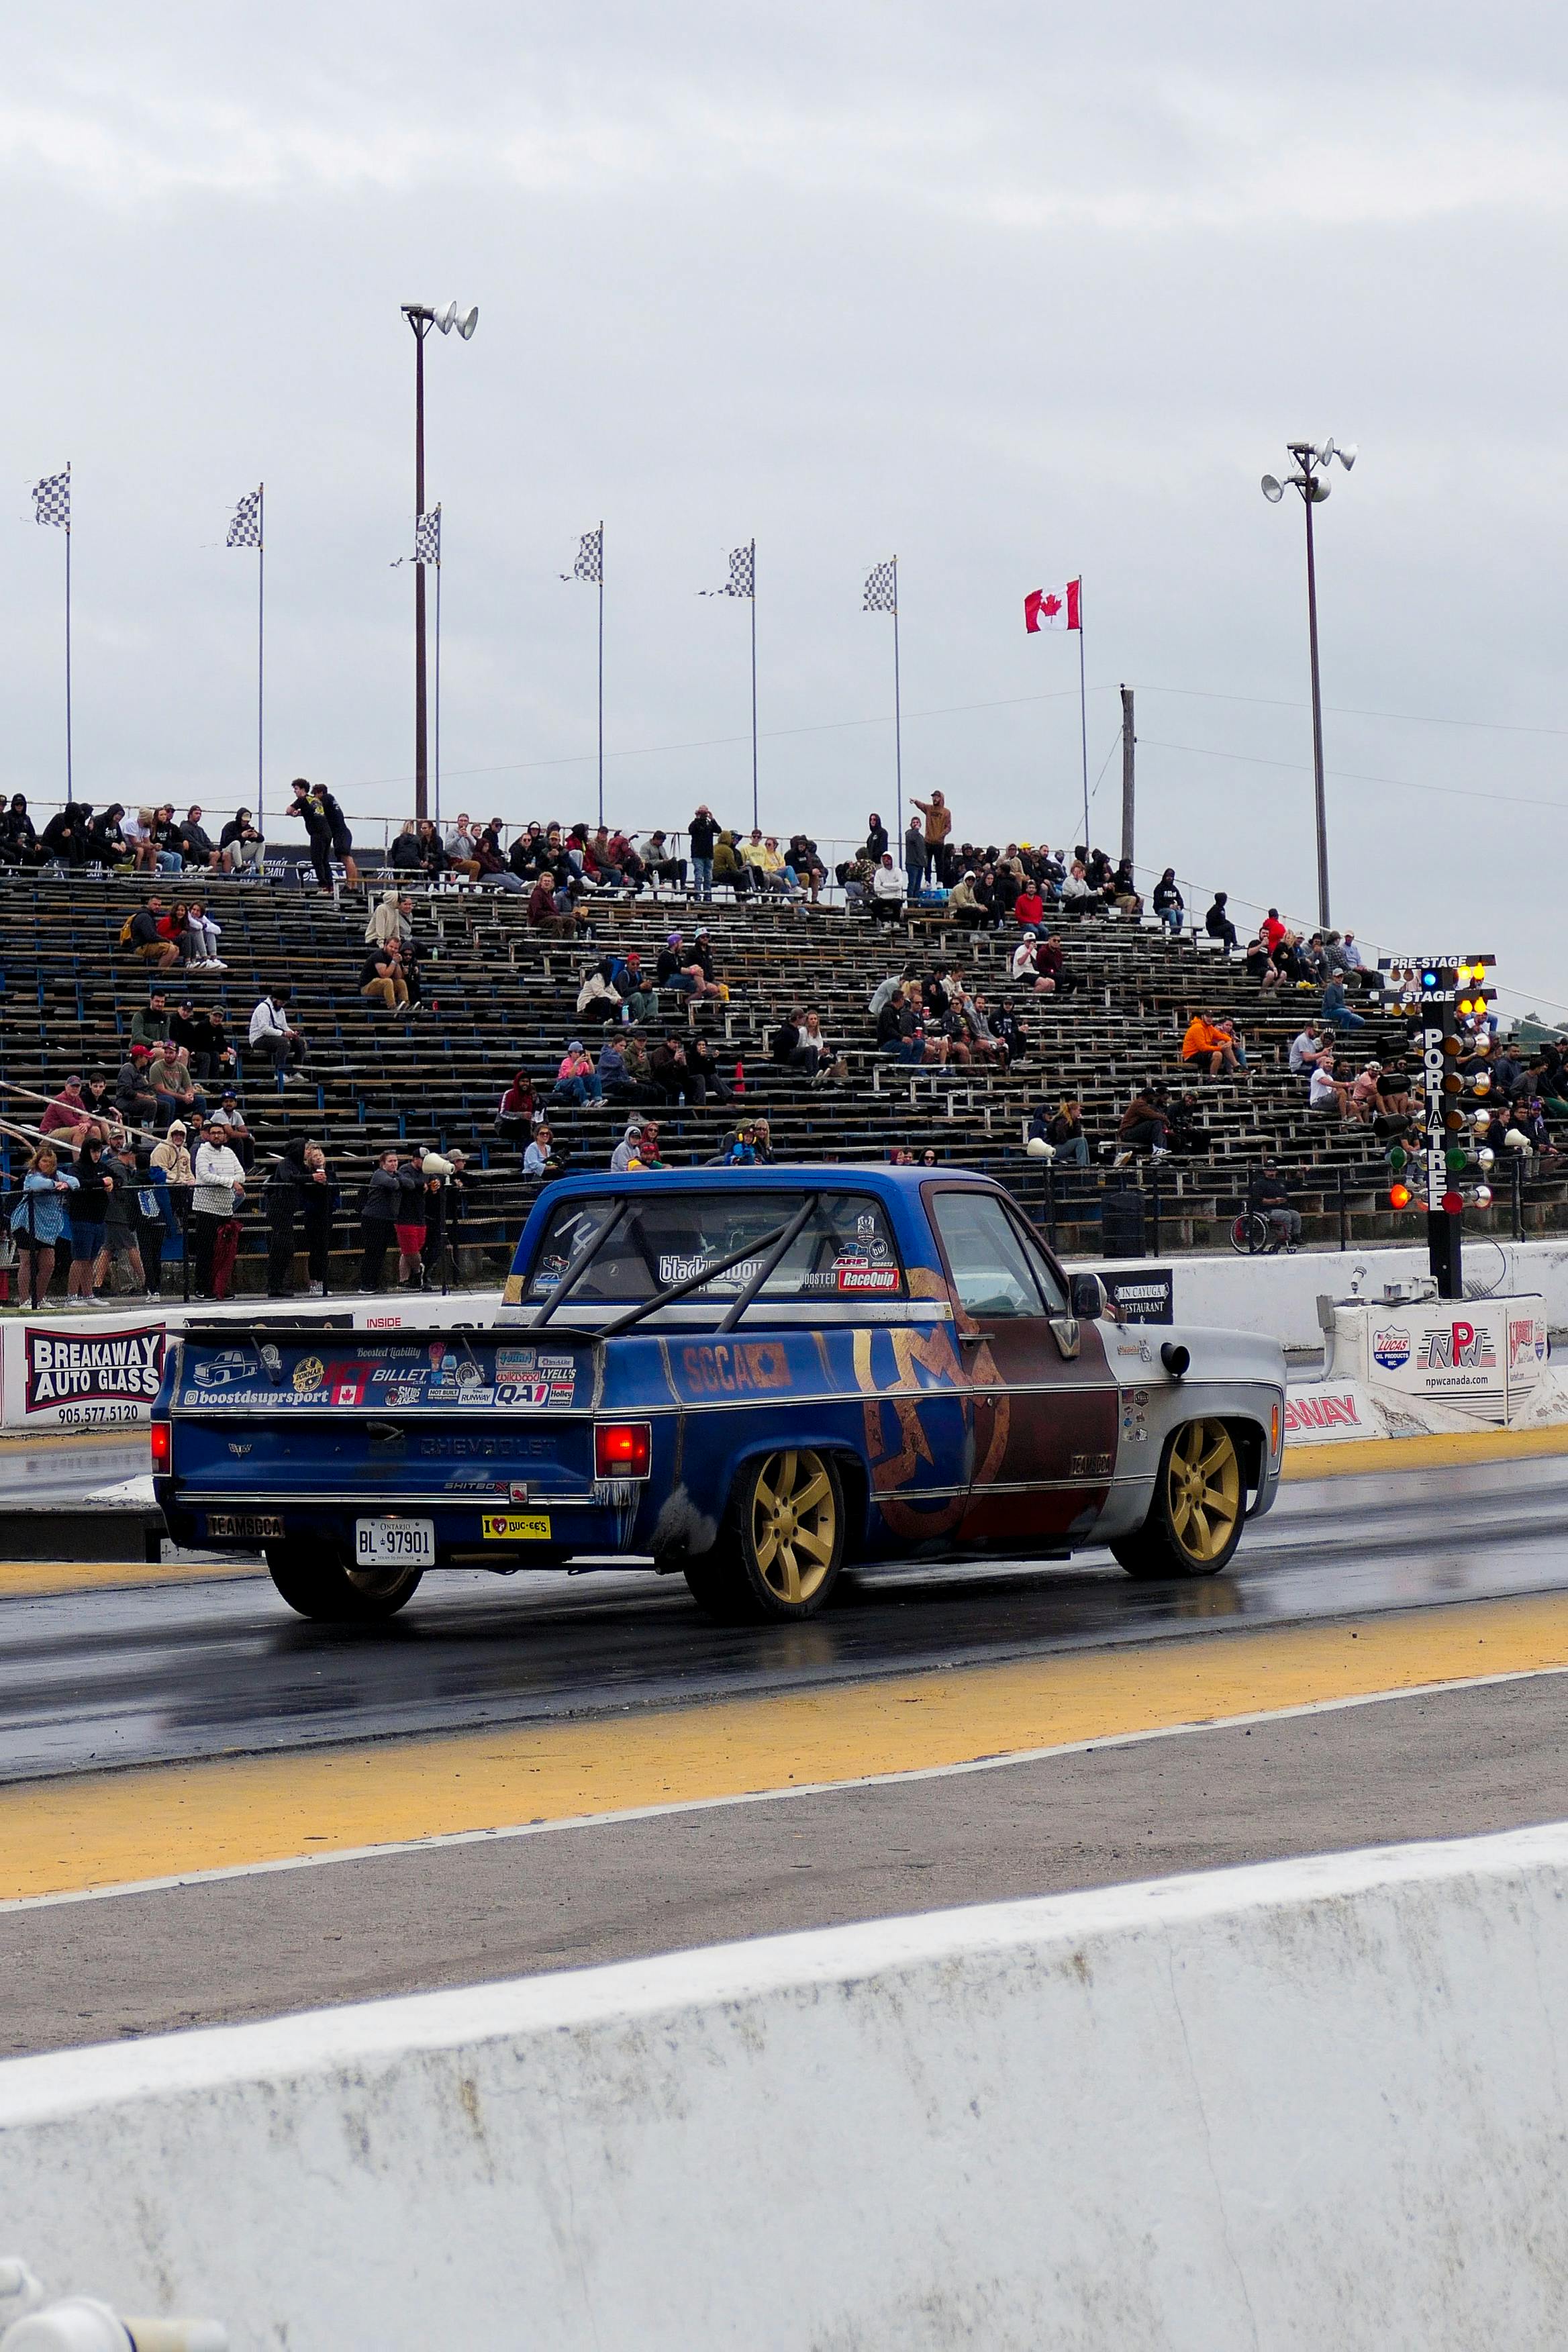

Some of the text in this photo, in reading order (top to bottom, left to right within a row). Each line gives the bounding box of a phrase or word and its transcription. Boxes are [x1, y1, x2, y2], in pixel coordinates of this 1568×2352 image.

[1389, 956, 1467, 969] PRE-STAGE
[1402, 990, 1456, 1003] STAGE
[1424, 1028, 1448, 1211] PORTATREE
[843, 1272, 895, 1287] RaceQuip
[1122, 1286, 1161, 1298] IN CAYUGA
[366, 1317, 401, 1328] INSIDE
[1377, 1340, 1408, 1351] LUCAS
[1428, 1322, 1483, 1368] NPW
[34, 1335, 160, 1369] BREAKAWAY
[356, 1347, 422, 1359] Boosted Liability
[540, 1369, 577, 1379] LYELL'S
[683, 1343, 754, 1393] SGCA
[372, 1369, 431, 1382] BILLET
[1426, 1375, 1488, 1388] npwcanada.com
[34, 1367, 160, 1402] AUTO GLASS
[199, 1389, 329, 1406] boostdsuprsport
[461, 1393, 491, 1402] RUNWAY
[497, 1384, 547, 1405] QA1
[550, 1390, 572, 1400] Holley
[58, 1405, 138, 1424] 905.577.5120
[444, 1481, 509, 1493] SHITBOX
[209, 1517, 283, 1536] TEAMSGCA
[483, 1520, 491, 1533] I
[359, 1531, 430, 1554] BL 97901
